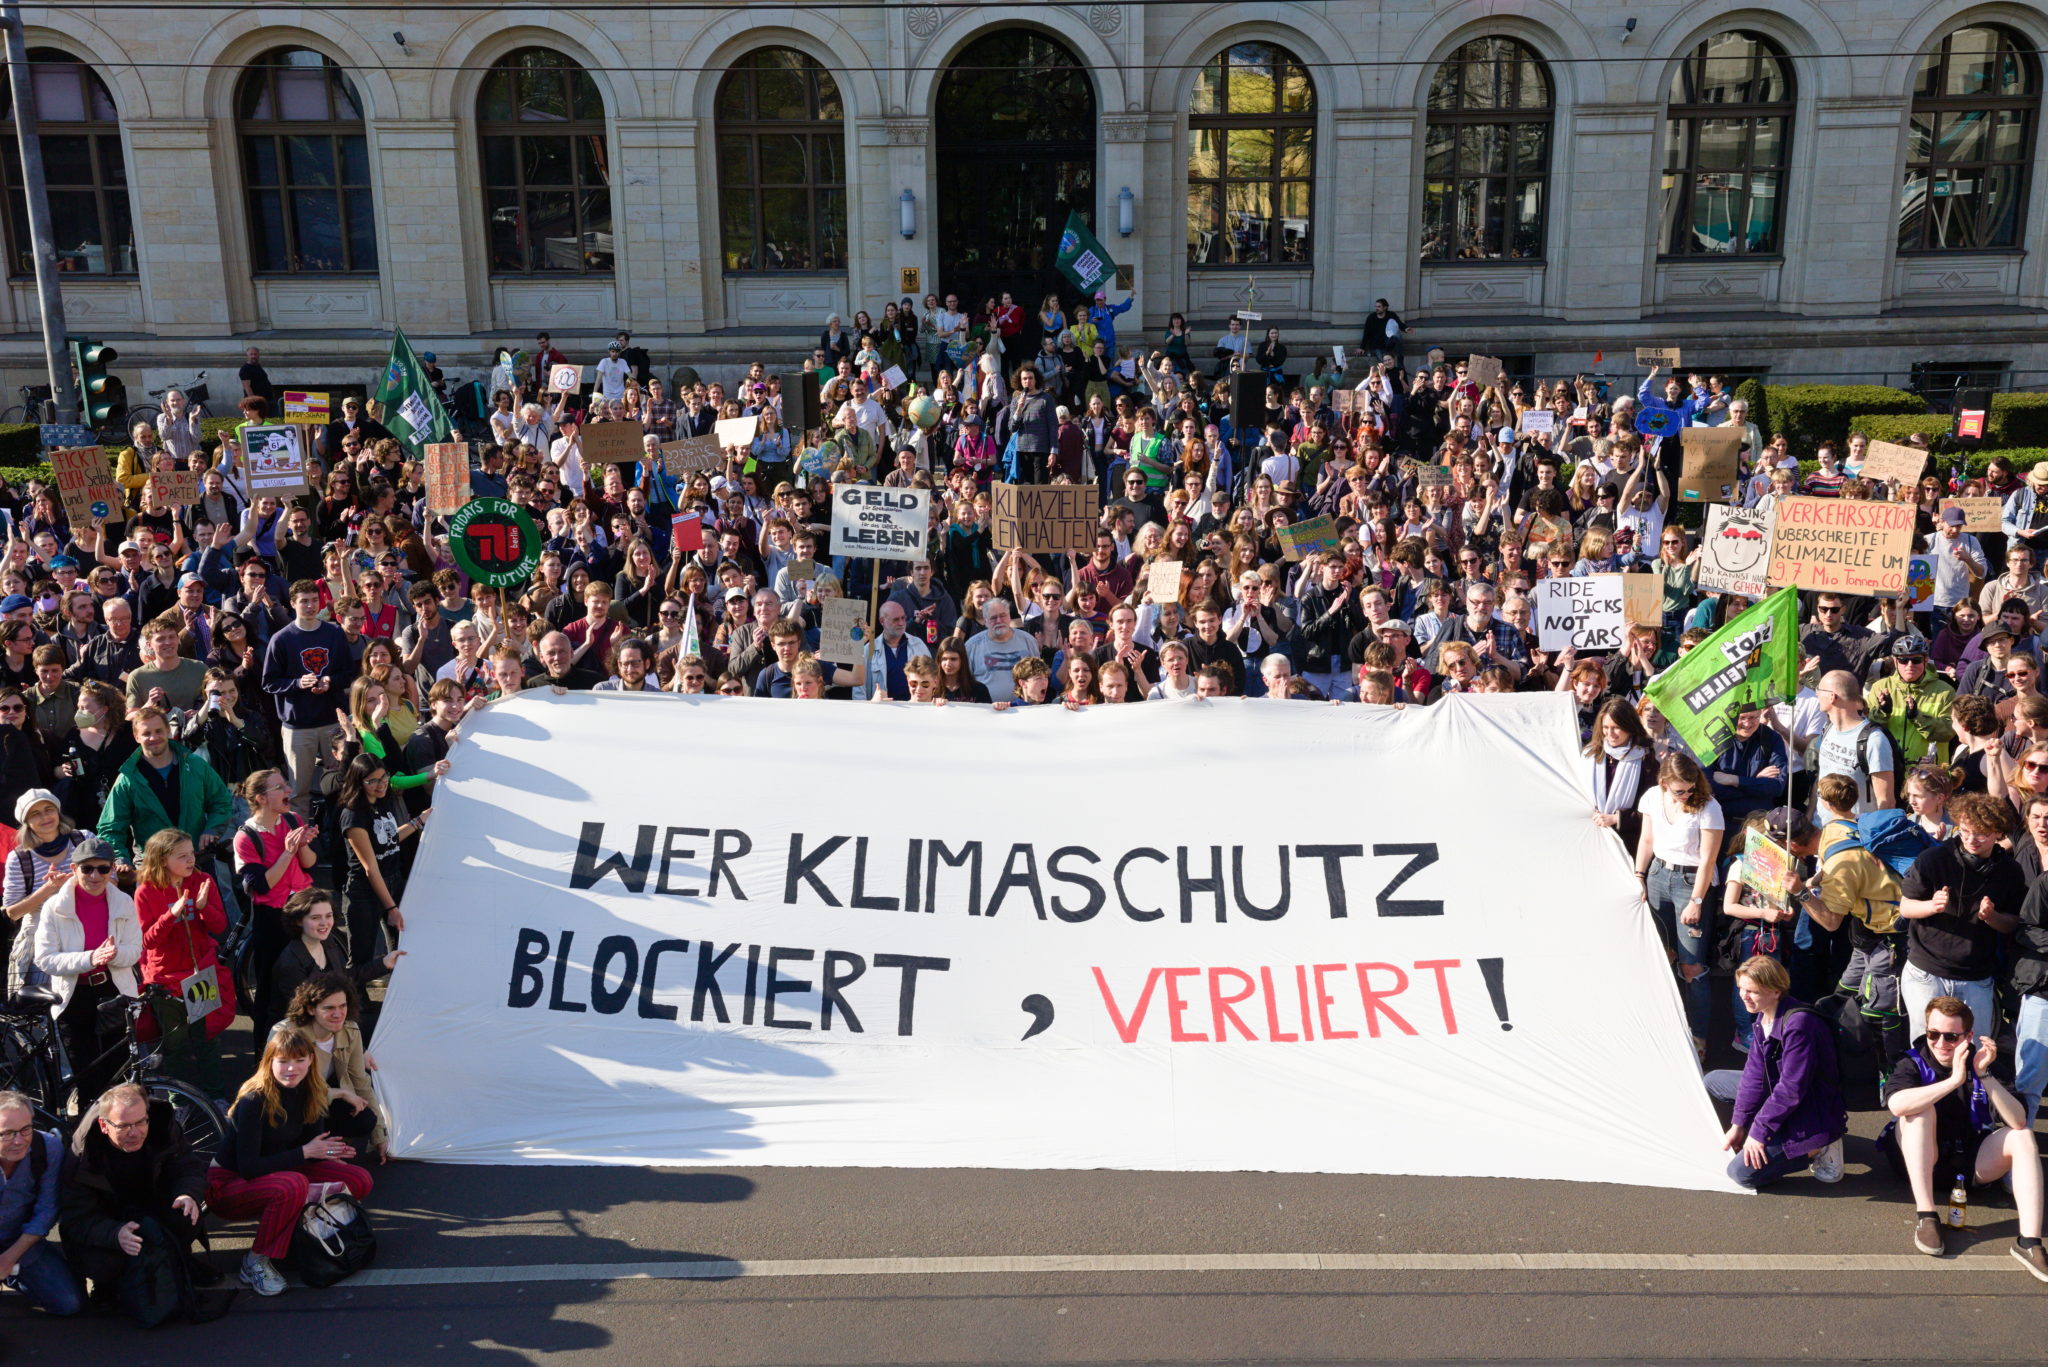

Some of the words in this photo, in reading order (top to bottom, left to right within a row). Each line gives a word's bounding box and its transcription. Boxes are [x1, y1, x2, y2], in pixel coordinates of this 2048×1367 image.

[57, 470, 85, 491] EUCH
[65, 490, 84, 507] und
[842, 489, 919, 510] GELD
[996, 487, 1098, 520] KLIMAZIELE
[451, 500, 484, 538] FRIDAYS
[494, 501, 518, 519] FOR
[859, 512, 893, 524] ODER
[1721, 506, 1766, 520] WISSING
[1780, 502, 1915, 531] VERKEHRSSEKTOR
[510, 527, 519, 549] berlin
[843, 527, 920, 547] LEBEN
[999, 519, 1097, 549] EINHALTEN
[1777, 525, 1888, 545] ÜBERSCHREITET
[1775, 543, 1874, 566] KLIMAZIELE
[1882, 555, 1903, 569] UM
[489, 555, 537, 586] FUTURE
[1702, 566, 1714, 574] DU
[1718, 571, 1749, 580] KANNST
[1813, 566, 1839, 585] Mio
[1844, 569, 1879, 588] Tonnen
[1550, 582, 1596, 598] RIDE
[1701, 576, 1728, 590] HAUSE
[1572, 599, 1622, 614] DICKS
[1545, 615, 1590, 631] NOT
[1571, 626, 1622, 648] CARS
[570, 822, 751, 900] WER
[785, 834, 1444, 922] KLIMASCHUTZ
[508, 927, 949, 1035] BLOCKIERT
